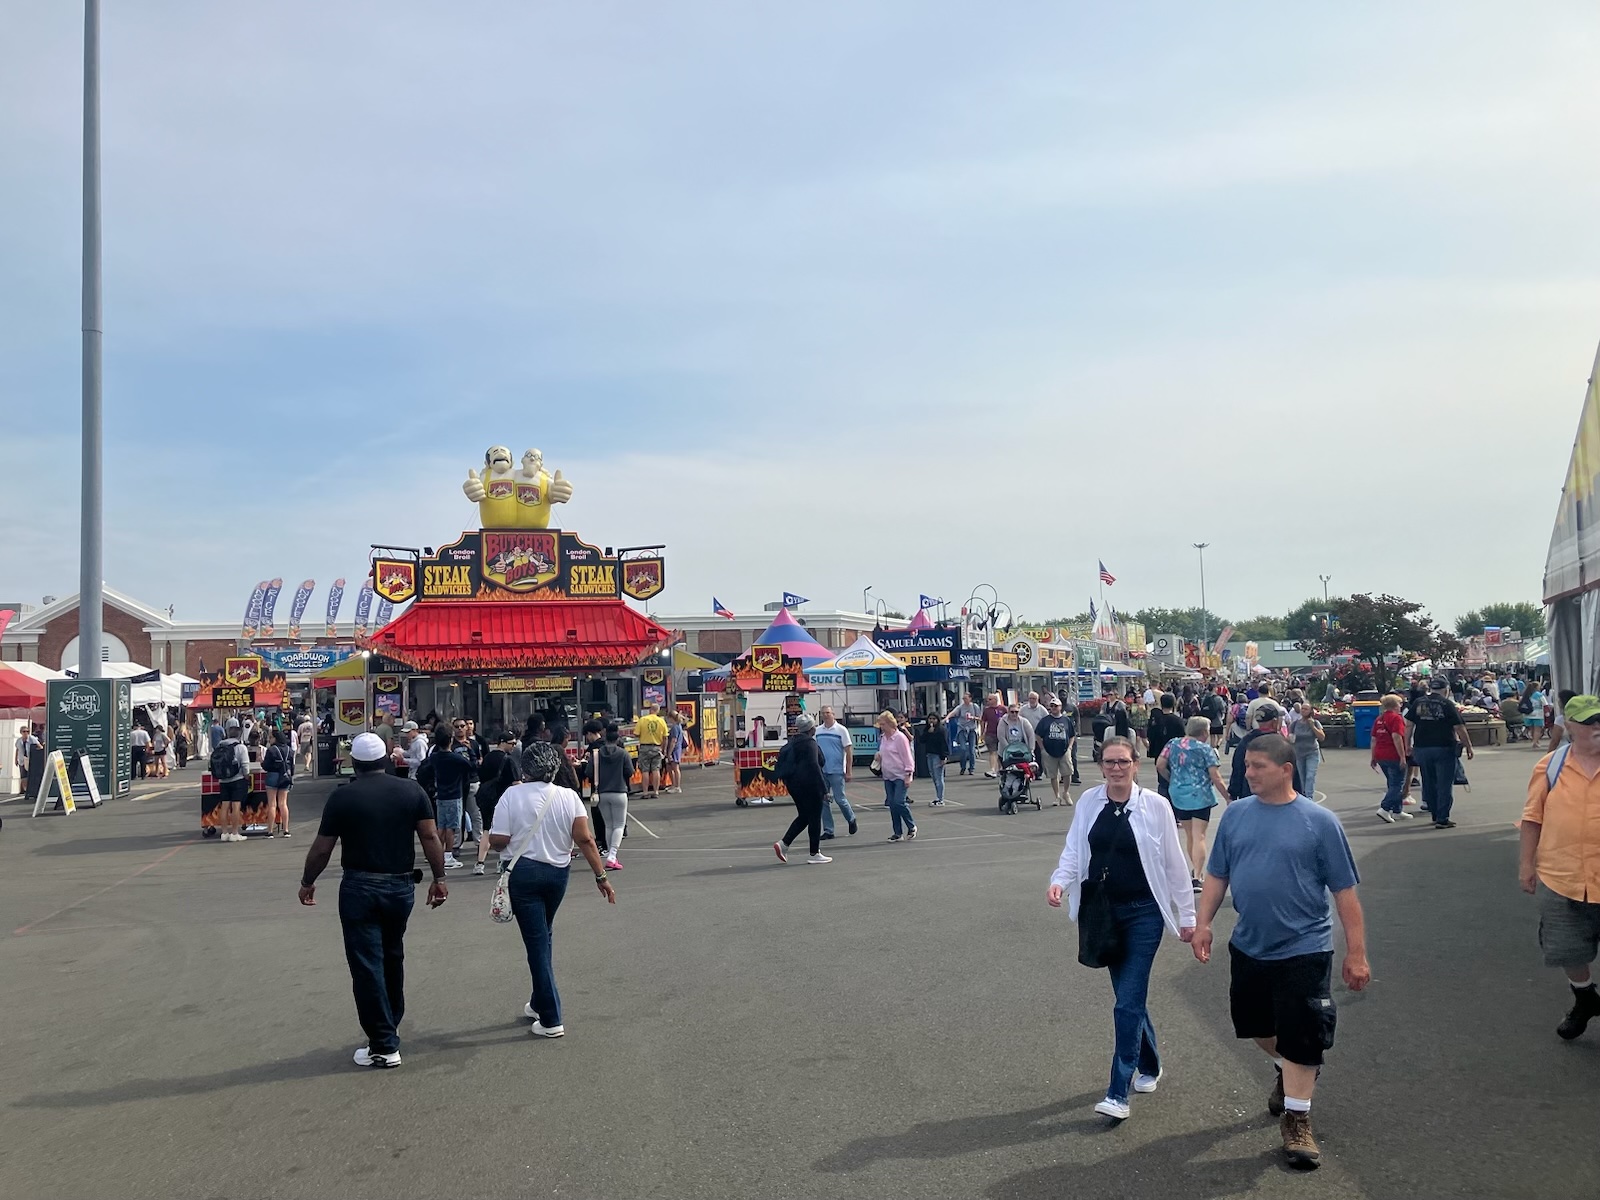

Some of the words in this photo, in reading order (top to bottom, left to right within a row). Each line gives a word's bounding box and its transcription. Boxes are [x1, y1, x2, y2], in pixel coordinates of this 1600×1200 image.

[486, 534, 555, 561] BUTCHER
[424, 565, 471, 585] STEAK
[506, 561, 536, 584] BOYS
[570, 565, 615, 584] STEAK
[424, 585, 471, 595] SANDWICHES
[570, 584, 615, 594] SANDWICHES
[264, 588, 278, 616] RICE
[359, 588, 372, 616] RICE
[877, 639, 916, 650] SAMUEL
[917, 637, 953, 648] ADAMS
[281, 652, 330, 664] BOARDWOK
[911, 656, 939, 664] BEER
[810, 676, 832, 684] SUN
[66, 691, 97, 703] Front
[71, 701, 100, 714] Porch
